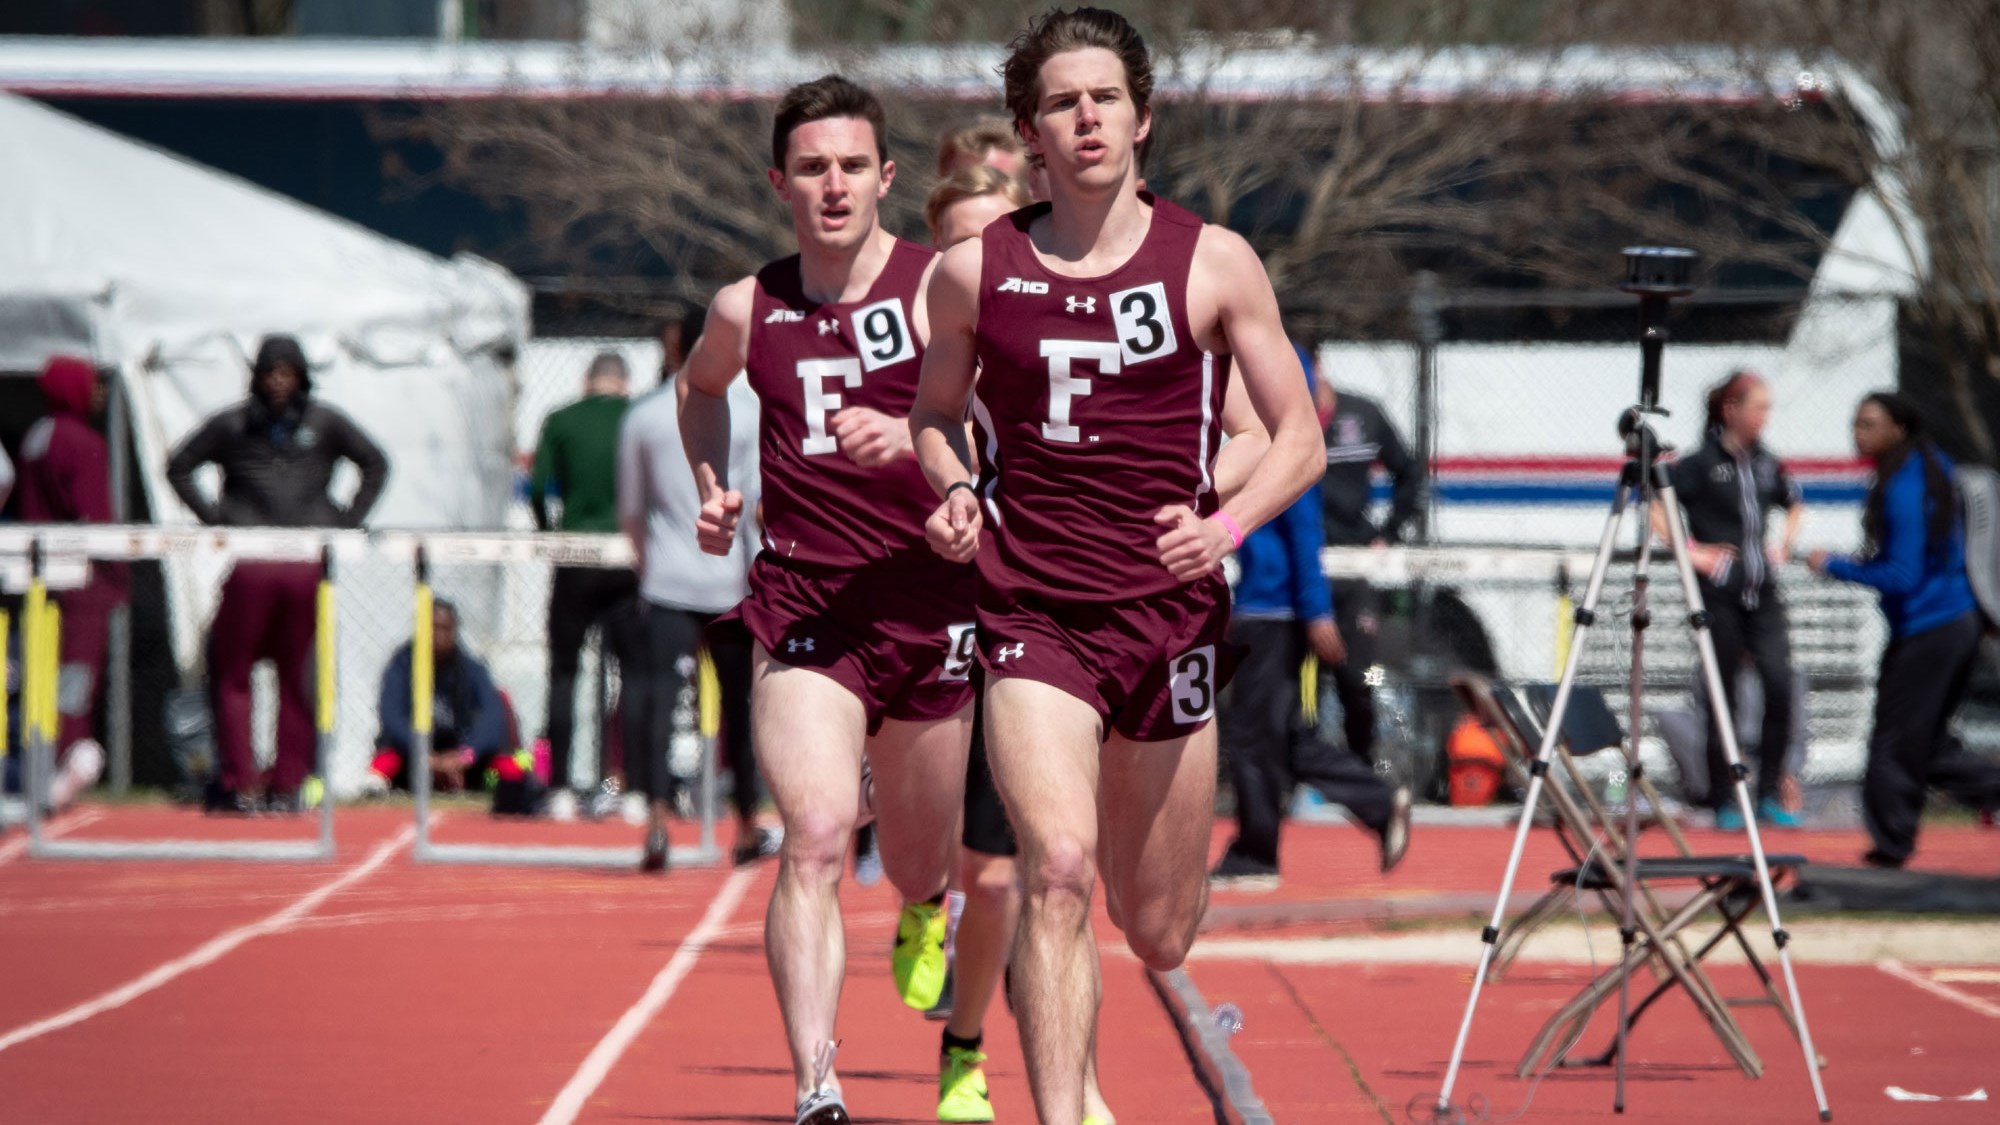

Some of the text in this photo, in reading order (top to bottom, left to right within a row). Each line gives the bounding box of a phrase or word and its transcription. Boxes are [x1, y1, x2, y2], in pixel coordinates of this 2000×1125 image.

[998, 277, 1048, 294] A10
[864, 307, 903, 361] 9
[1120, 291, 1164, 355] 3
[796, 358, 862, 455] F
[1040, 339, 1121, 442] F
[1176, 653, 1211, 716] 3
